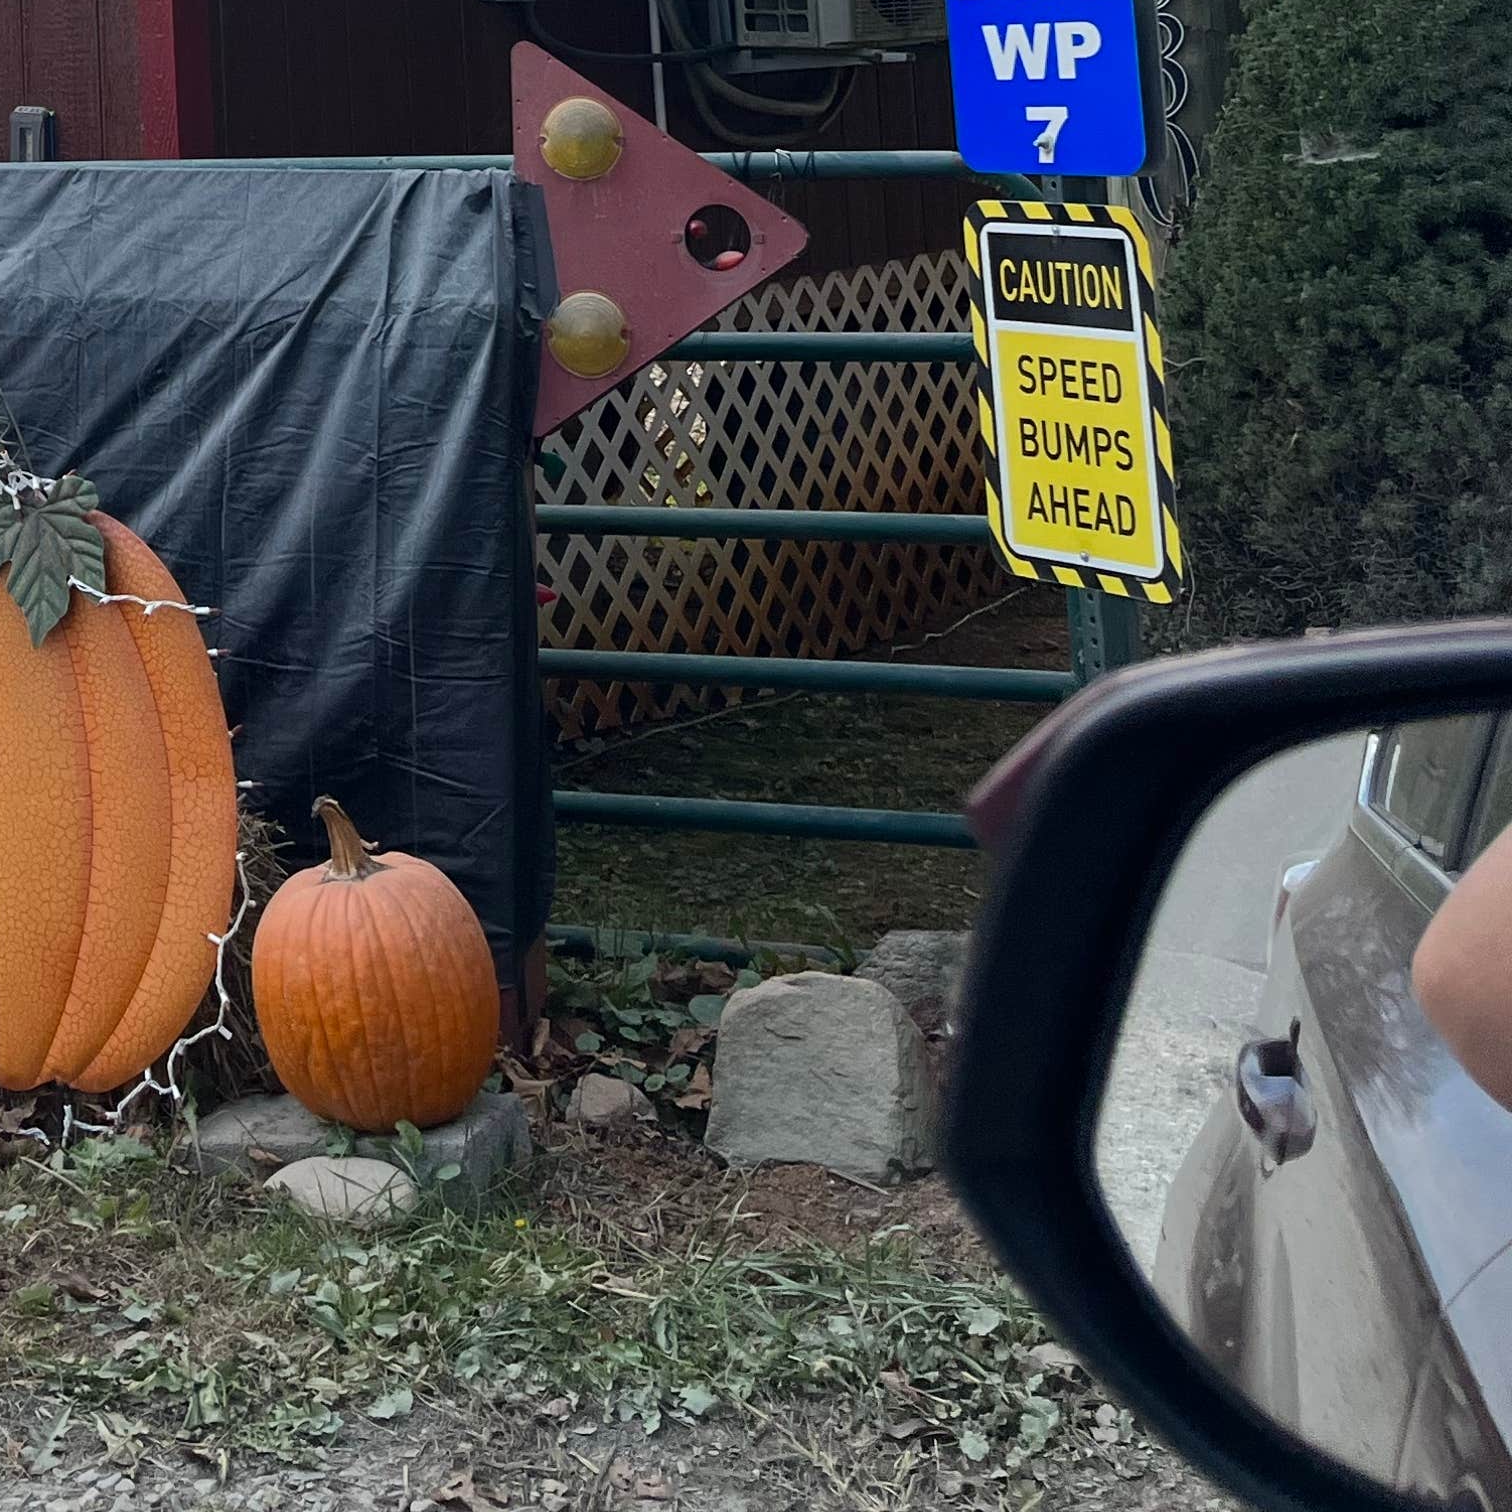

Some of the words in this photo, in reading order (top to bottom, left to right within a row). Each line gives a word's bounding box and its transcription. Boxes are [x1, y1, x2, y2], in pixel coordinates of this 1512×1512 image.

[981, 21, 1102, 81] WP
[1025, 106, 1069, 164] 7
[999, 258, 1124, 311] CAUTION
[1017, 354, 1122, 404] SPEED
[1019, 418, 1134, 471] BUMPS
[1027, 481, 1137, 536] AHEAD
